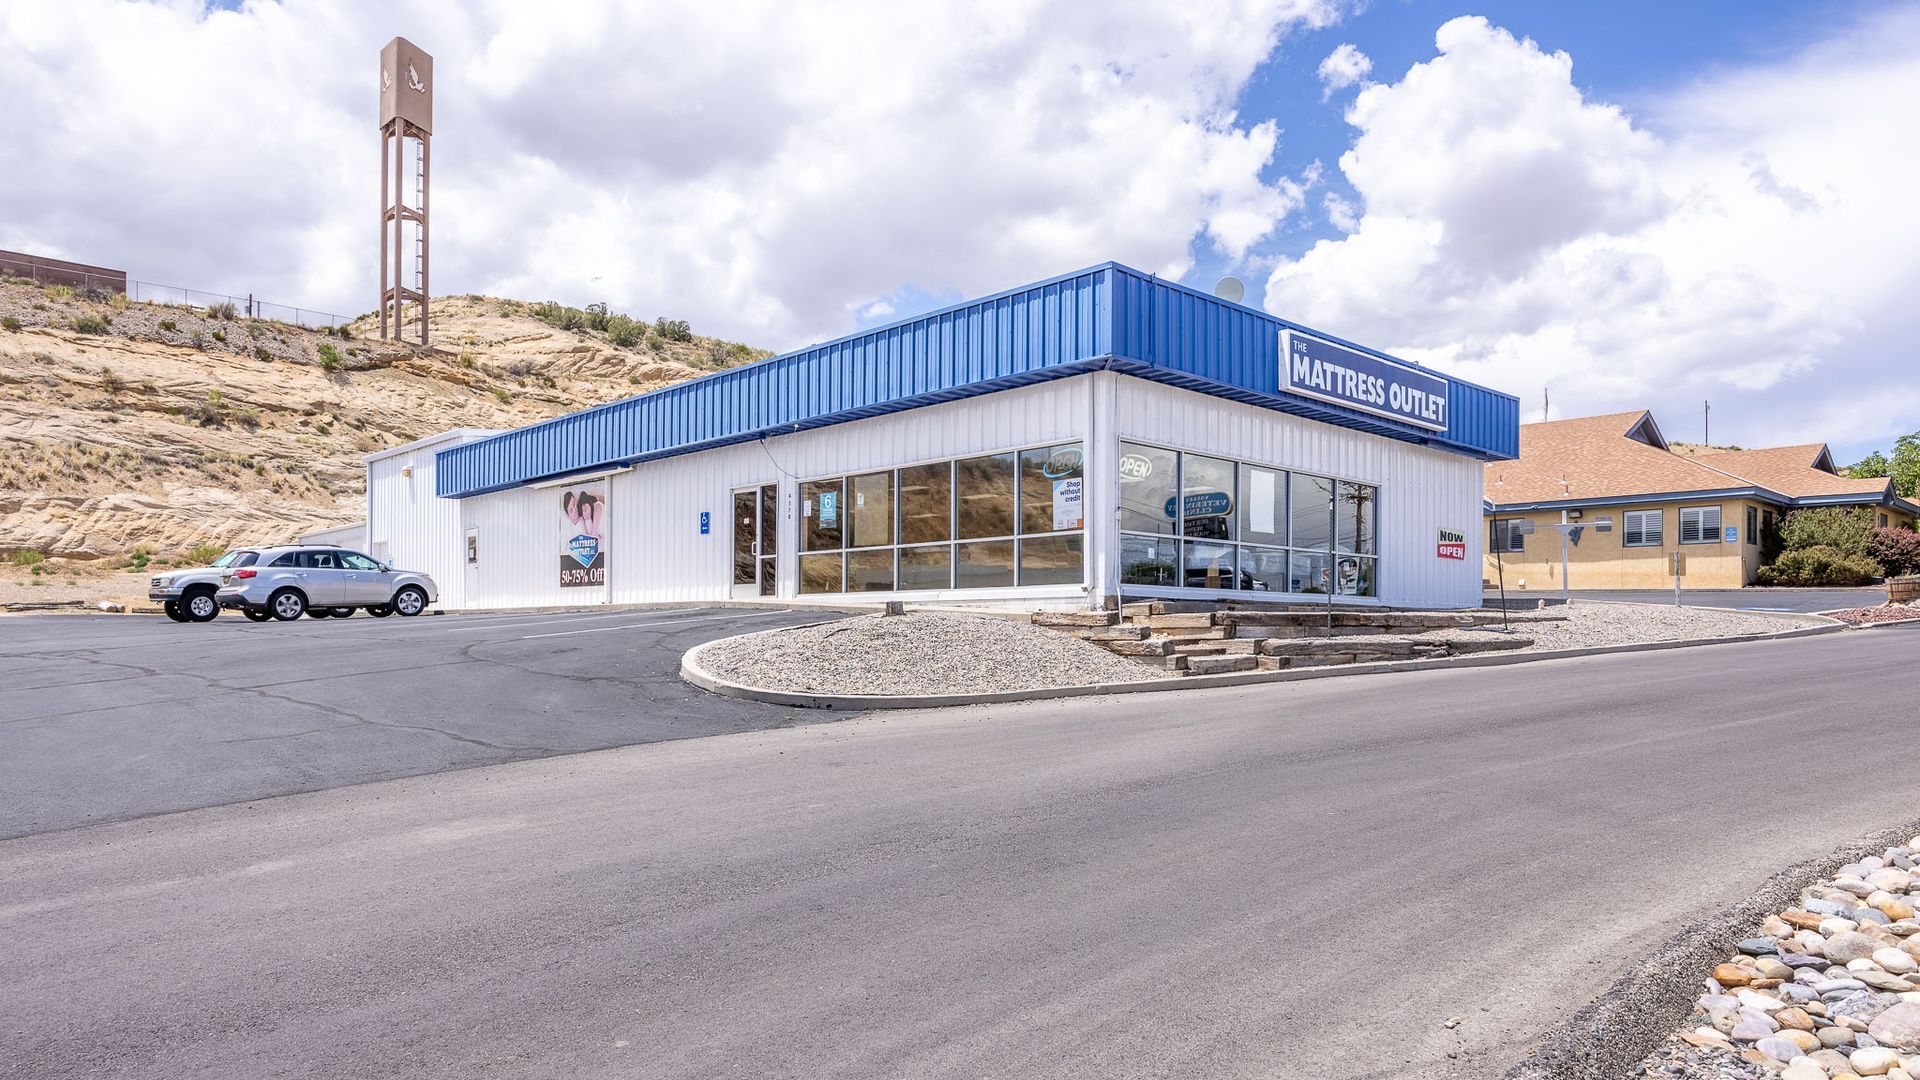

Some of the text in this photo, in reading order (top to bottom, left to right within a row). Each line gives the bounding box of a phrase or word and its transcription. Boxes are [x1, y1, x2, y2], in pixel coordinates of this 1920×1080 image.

[1293, 340, 1307, 353] THE
[1293, 353, 1445, 422] MATTRESS OUTLET
[1120, 457, 1149, 478] OPEN
[1060, 488, 1080, 496] without
[824, 495, 832, 508] 6
[1440, 530, 1463, 542] NOW
[571, 539, 596, 548] MATTRESS
[1440, 546, 1464, 558] OPEN
[561, 569, 588, 584] 50-75%
